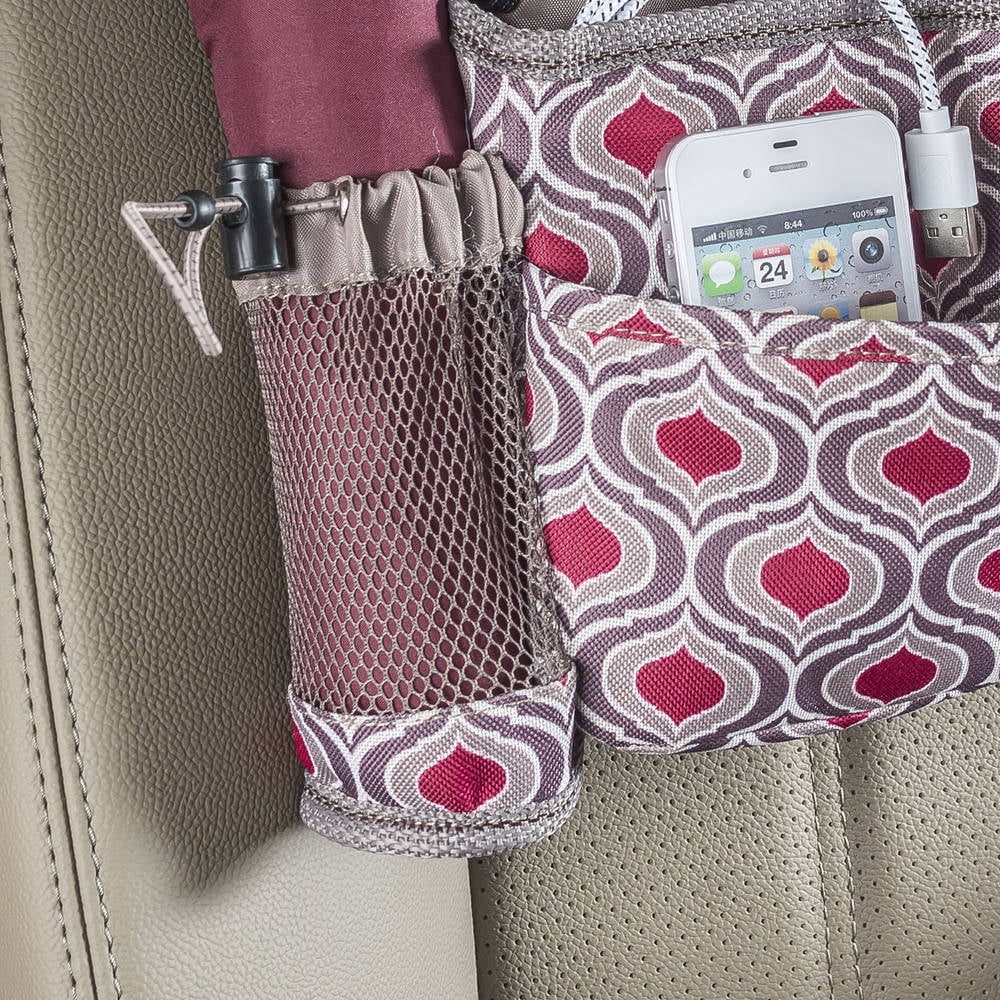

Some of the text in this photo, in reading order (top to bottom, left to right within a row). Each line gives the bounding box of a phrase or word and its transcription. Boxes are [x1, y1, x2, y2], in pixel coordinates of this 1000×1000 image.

[852, 209, 873, 219] 100%
[784, 219, 803, 230] 8:44
[718, 228, 752, 241] 中国移动
[760, 259, 788, 283] 24
